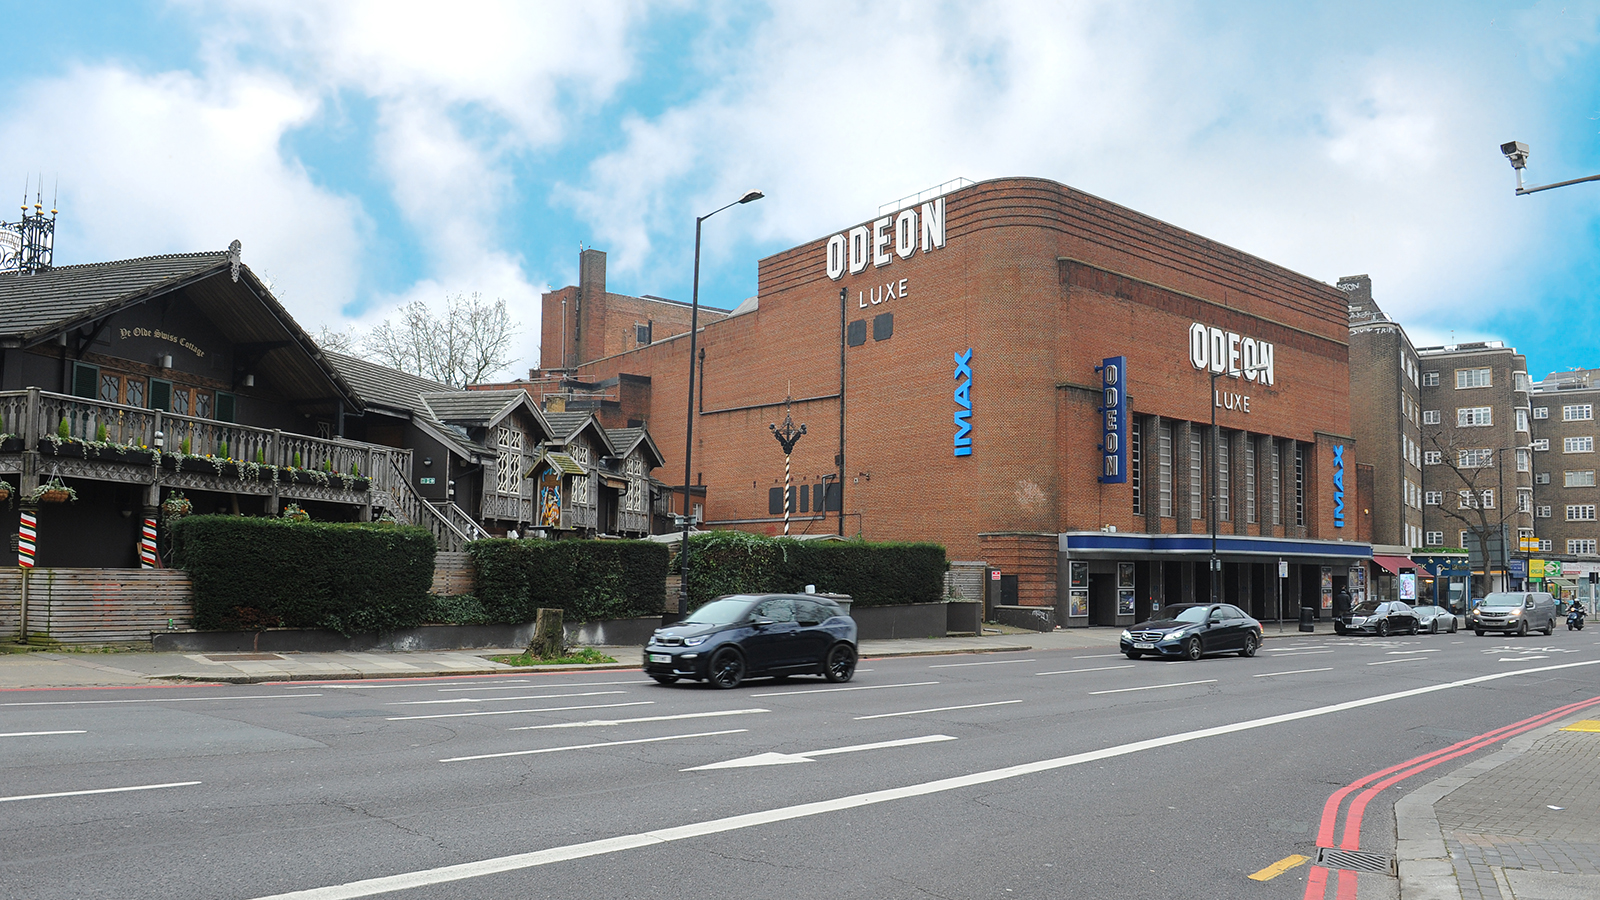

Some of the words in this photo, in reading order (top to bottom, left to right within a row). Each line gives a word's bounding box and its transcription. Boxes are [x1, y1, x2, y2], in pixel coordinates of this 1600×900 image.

[827, 197, 946, 281] ODEON
[859, 278, 909, 309] LUXE
[119, 328, 131, 340] Ye
[133, 327, 152, 337] Olde
[153, 329, 178, 343] Swiss
[179, 338, 205, 357] Cottage
[1189, 322, 1274, 387] ODEON
[954, 347, 972, 457] IMAX
[1105, 364, 1118, 476] ODEON
[1215, 390, 1250, 413] LUXE
[1333, 445, 1345, 528] IMAX
